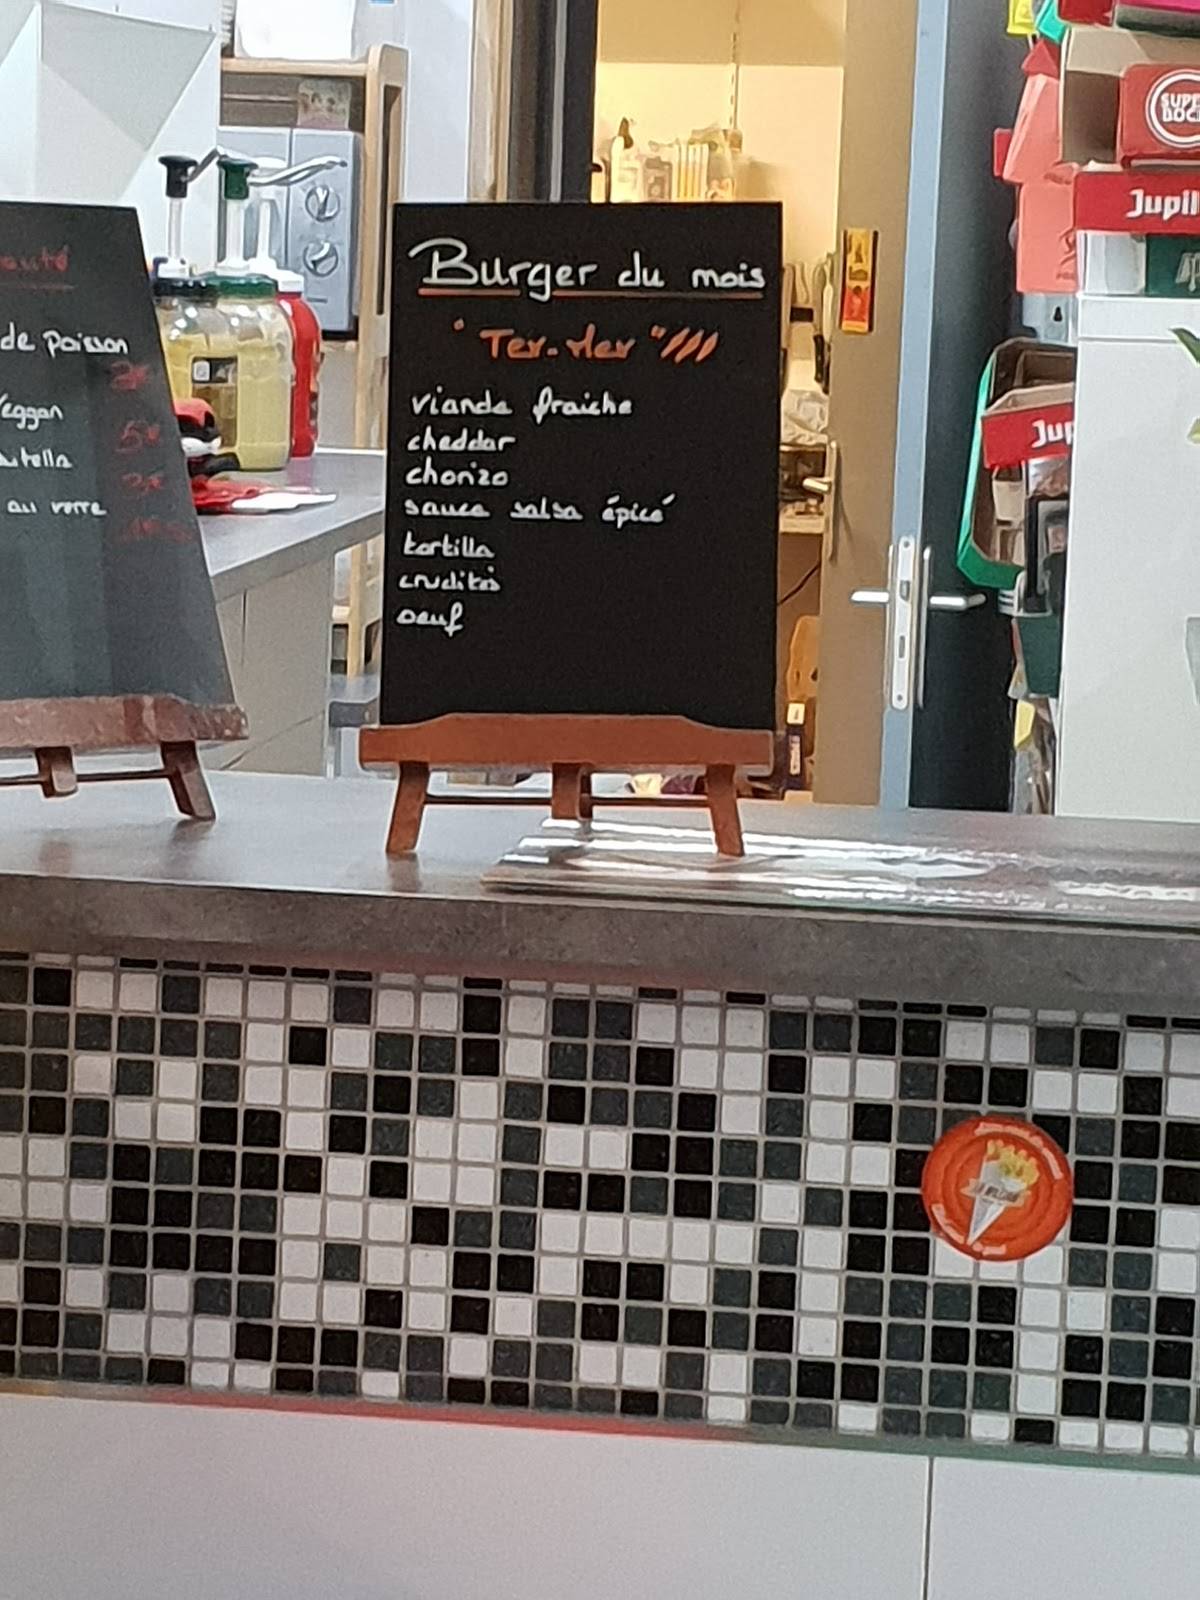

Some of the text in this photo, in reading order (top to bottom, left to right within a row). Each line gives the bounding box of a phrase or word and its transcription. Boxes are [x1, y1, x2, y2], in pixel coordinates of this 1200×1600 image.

[1126, 189, 1200, 221] Jupil
[408, 238, 766, 302] Burger du mois
[0, 321, 36, 351] de
[411, 385, 632, 424] viande fraiche
[407, 425, 516, 451] cheddar
[405, 455, 509, 486] chorizo
[6, 499, 38, 514] au
[404, 498, 490, 517] sauce
[510, 497, 583, 520] salsa
[403, 530, 495, 558] tortilla
[396, 601, 464, 637] oeuf
